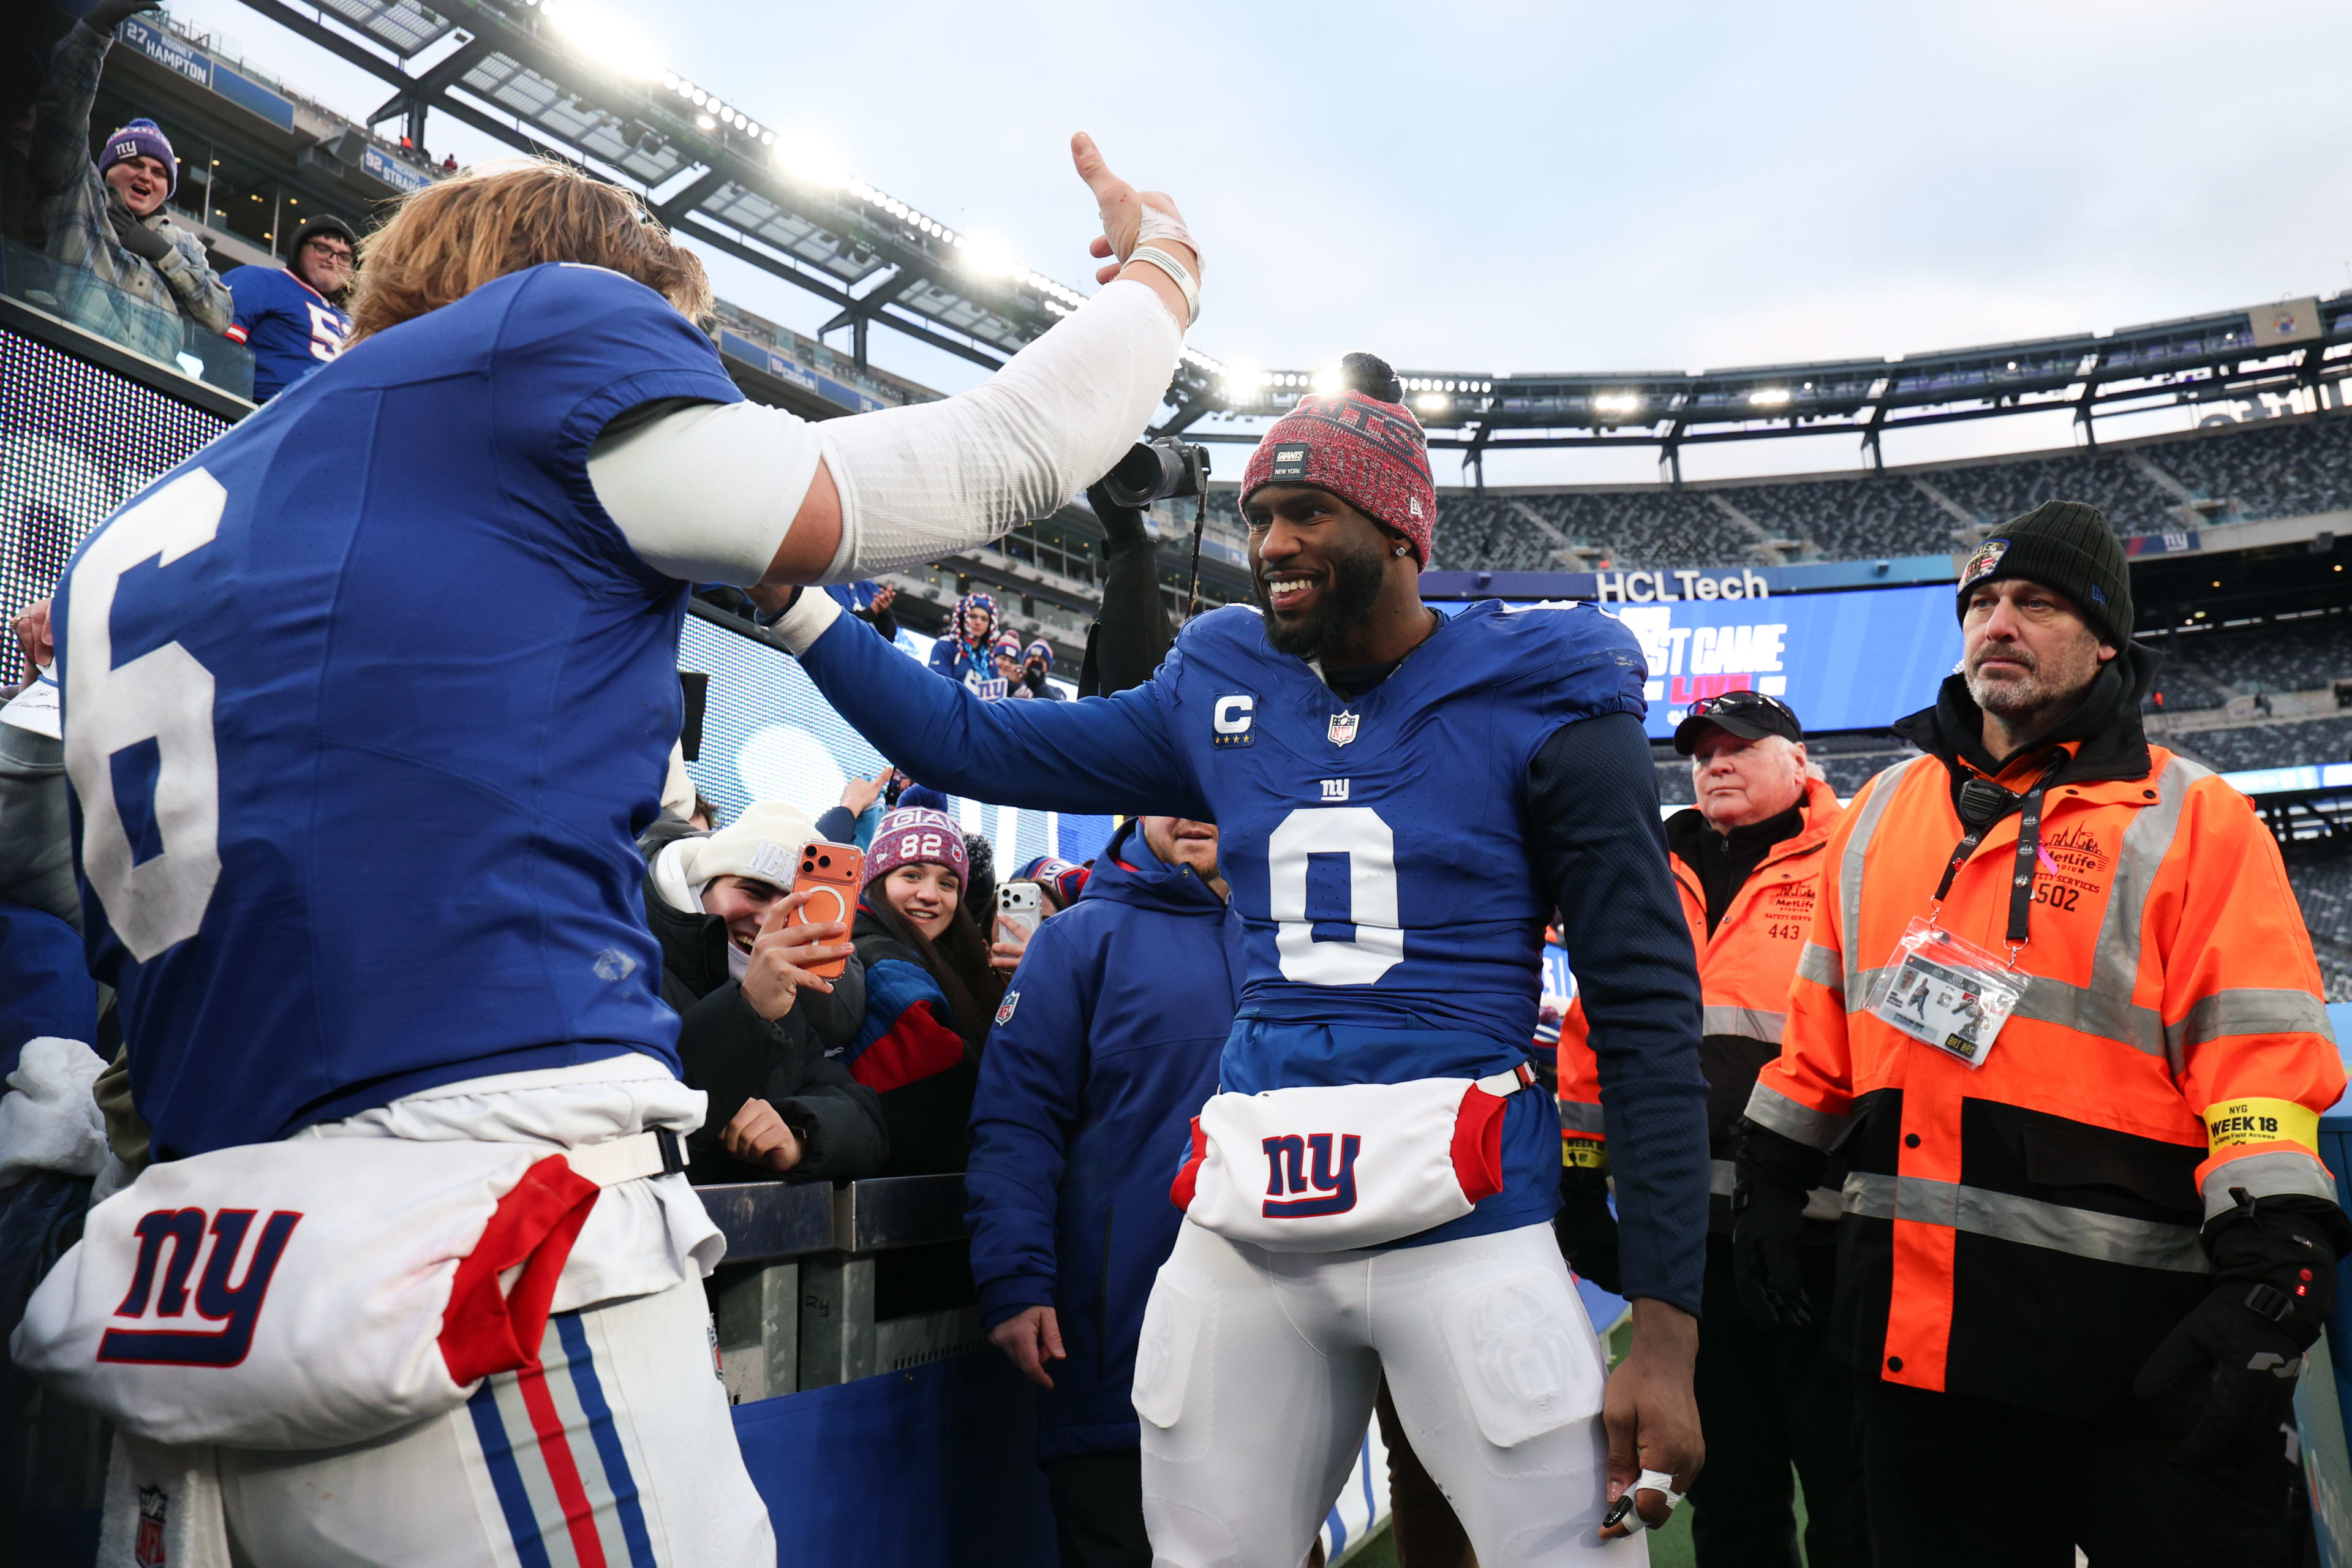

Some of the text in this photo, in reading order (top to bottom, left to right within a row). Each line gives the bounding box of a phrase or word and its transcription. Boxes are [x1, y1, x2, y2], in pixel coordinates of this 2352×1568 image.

[126, 22, 148, 44] 27
[146, 39, 207, 85] HAMPTON
[1276, 451, 1304, 460] GIANTS
[1596, 568, 1770, 603] HCLTech
[1690, 624, 1788, 675] GAME
[65, 466, 227, 964] 6
[1213, 695, 1253, 734] C
[1332, 726, 1351, 741] NFL
[900, 834, 943, 858] 82
[2056, 875, 2100, 894] SERVICES
[1268, 807, 1404, 985] 0
[1776, 899, 1814, 908] MetLife
[2036, 883, 2080, 912] 502
[1768, 924, 1800, 940] 443
[1947, 1036, 1975, 1056] BRI BRI
[2230, 1104, 2248, 1115] NYG
[2210, 1116, 2278, 1137] WEEK 18
